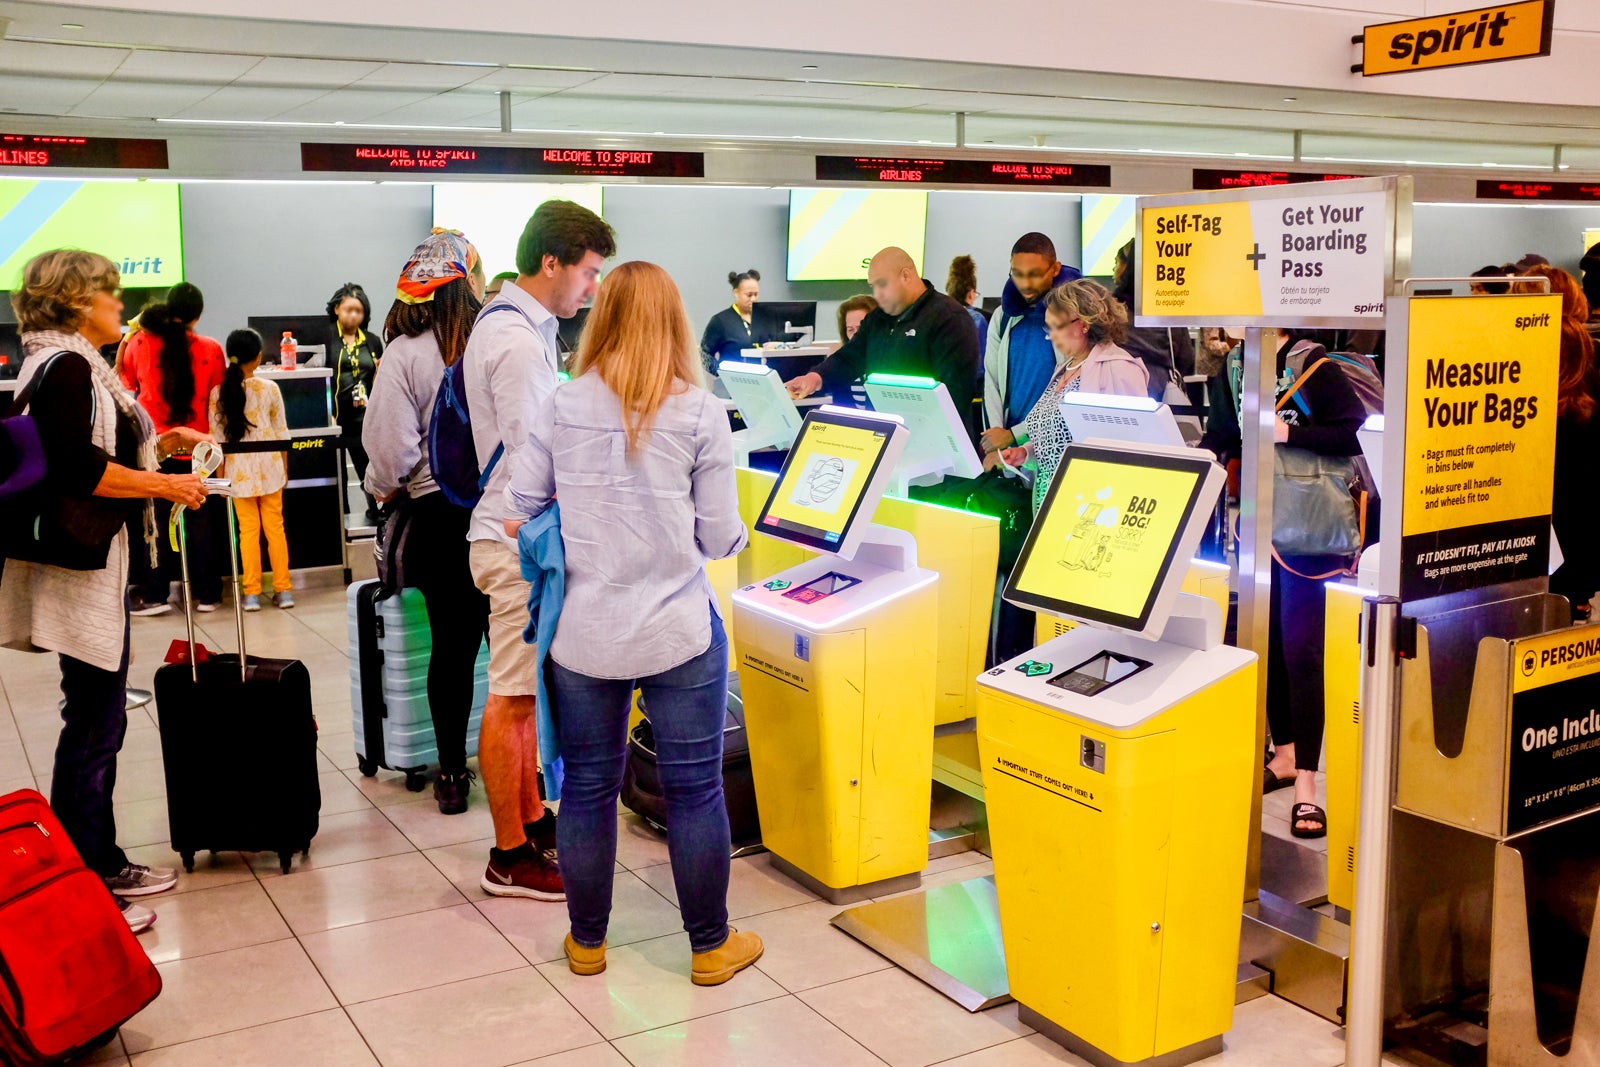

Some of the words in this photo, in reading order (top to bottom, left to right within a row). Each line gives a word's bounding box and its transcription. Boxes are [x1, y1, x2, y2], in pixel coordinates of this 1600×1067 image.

[1388, 11, 1510, 65] spirit
[0, 150, 48, 165] LINES
[543, 150, 592, 162] WELCOME
[596, 151, 611, 163] TO
[614, 152, 653, 164] SPIRIT
[880, 170, 922, 181] AIRLINES
[1282, 207, 1314, 226] Get
[1319, 204, 1364, 224] Your
[1156, 214, 1222, 236] Self-Tag
[1156, 241, 1193, 258] Your
[1282, 228, 1367, 255] Boarding
[117, 257, 162, 274] irit
[1156, 264, 1186, 286] Bag
[1281, 259, 1323, 278] Pass
[1308, 286, 1330, 295] tarjeta
[1280, 297, 1288, 305] de
[1289, 297, 1322, 306] embarque
[1353, 302, 1384, 315] spirit
[1514, 313, 1551, 331] spirit
[1425, 358, 1521, 390] Measure
[1424, 397, 1478, 429] Your
[1484, 393, 1538, 430] Bags
[292, 439, 325, 450] spirit
[1426, 449, 1444, 461] Bags
[1445, 446, 1464, 458] must
[1466, 444, 1474, 455] fit
[1475, 440, 1516, 455] completely
[1426, 463, 1434, 474] in
[1435, 461, 1450, 473] bins
[1452, 459, 1474, 471] below
[1425, 484, 1444, 496] Make
[1445, 482, 1462, 493] sure
[1463, 479, 1472, 491] all
[1473, 476, 1502, 489] handles
[1127, 495, 1158, 515] BAD
[1425, 498, 1439, 510] and
[1440, 494, 1466, 507] wheels
[1467, 492, 1476, 504] fit
[1477, 492, 1490, 503] too
[1121, 514, 1151, 529] DOG!
[1417, 554, 1425, 565] IF
[1425, 552, 1434, 563] IT
[1434, 546, 1467, 562] DOESN'T
[1467, 544, 1480, 557] FIT,
[1481, 541, 1497, 554] PAY
[1496, 540, 1507, 552] AT
[1506, 539, 1513, 550] A
[1513, 535, 1537, 549] KIOSK
[1424, 568, 1439, 578] Bags
[1440, 566, 1450, 575] are
[1450, 563, 1467, 573] more
[1467, 558, 1497, 571] expensive
[1497, 557, 1504, 565] at
[1504, 553, 1515, 564] the
[1515, 552, 1528, 564] gate
[1521, 725, 1558, 752] One
[1002, 759, 1028, 775] IMPORTANT
[1029, 769, 1043, 780] STUFF
[1044, 776, 1061, 787] COMES
[1062, 783, 1073, 792] OUT
[1536, 795, 1541, 803] X
[1553, 790, 1558, 798] X
